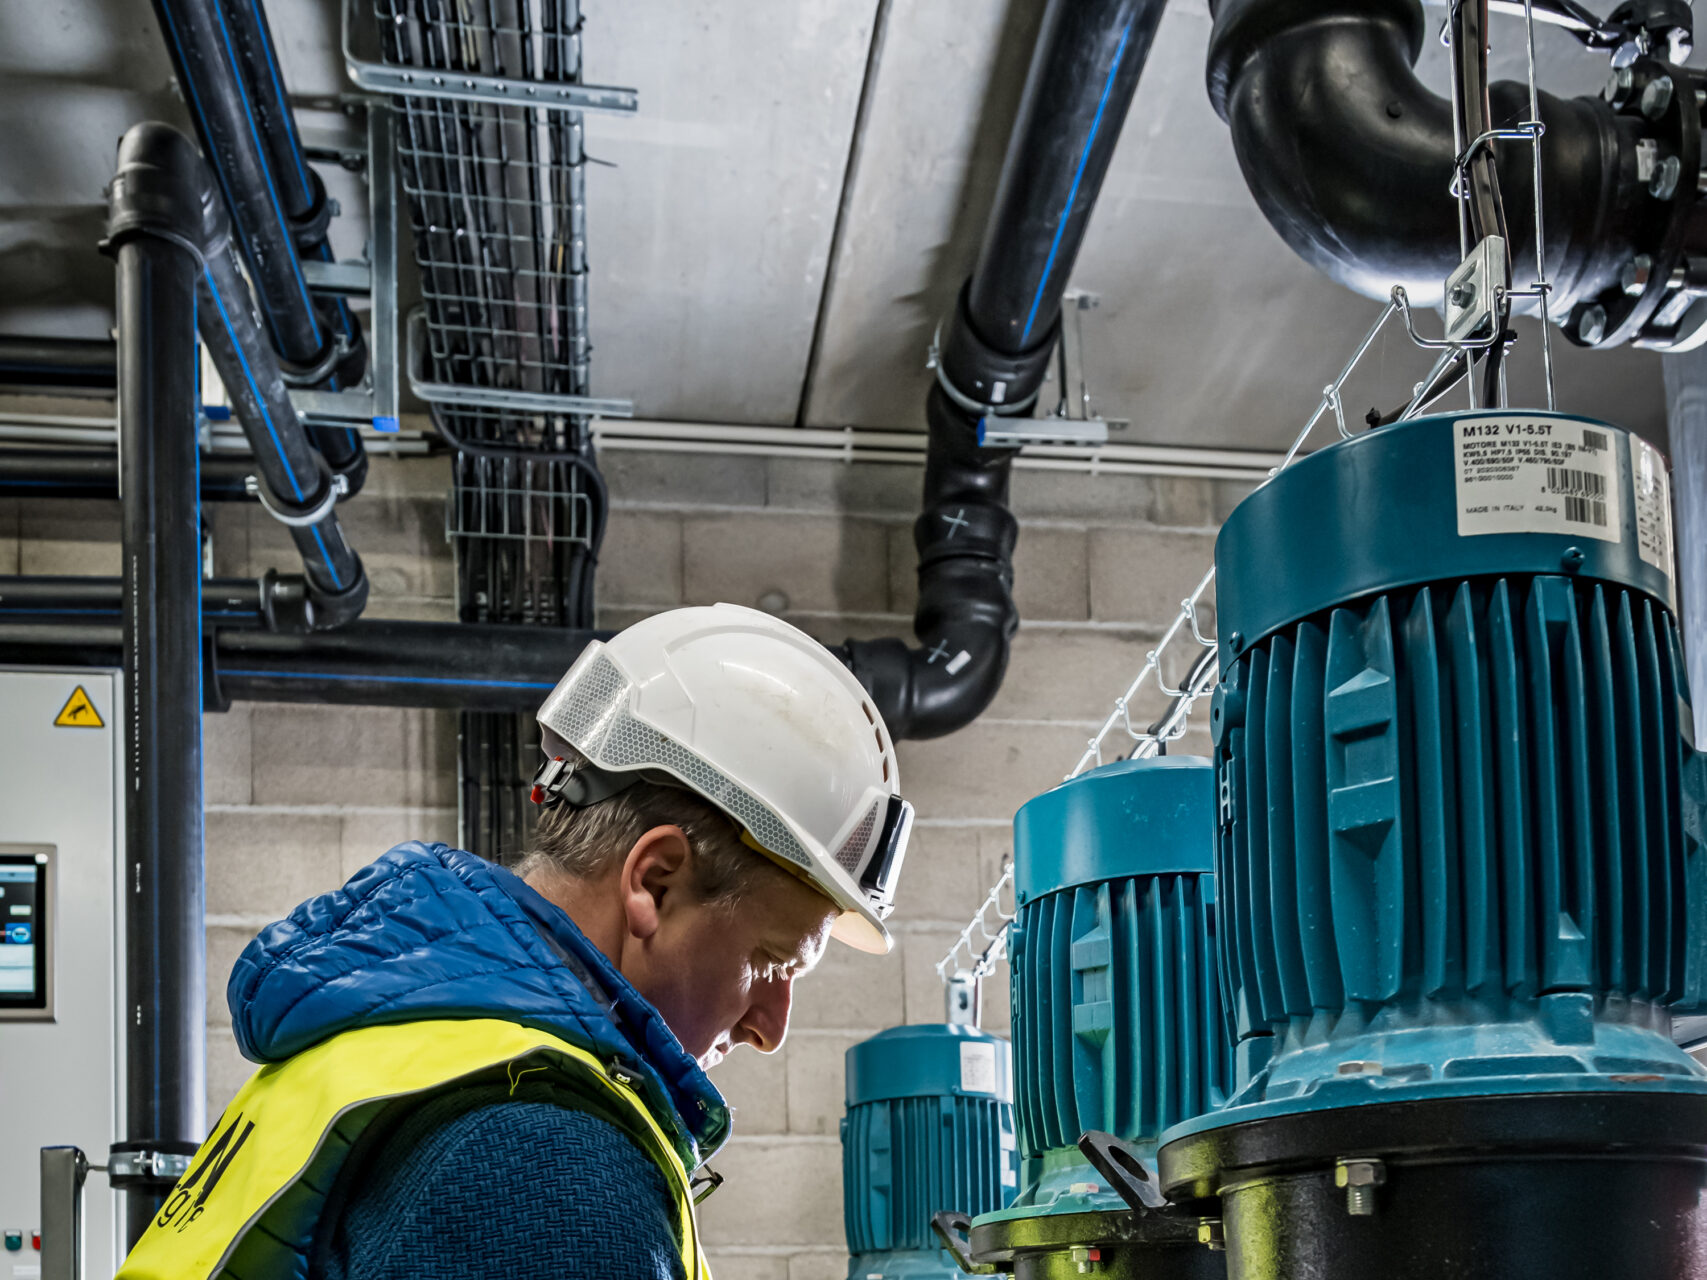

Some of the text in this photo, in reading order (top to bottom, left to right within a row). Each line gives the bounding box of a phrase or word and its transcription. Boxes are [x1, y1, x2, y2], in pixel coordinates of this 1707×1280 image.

[1463, 423, 1553, 437] M132 V1-5.5T
[1463, 440, 1497, 450] MOTORE
[1466, 506, 1489, 514] MADE
[1491, 504, 1501, 512] IN
[1503, 504, 1525, 512] ITALY
